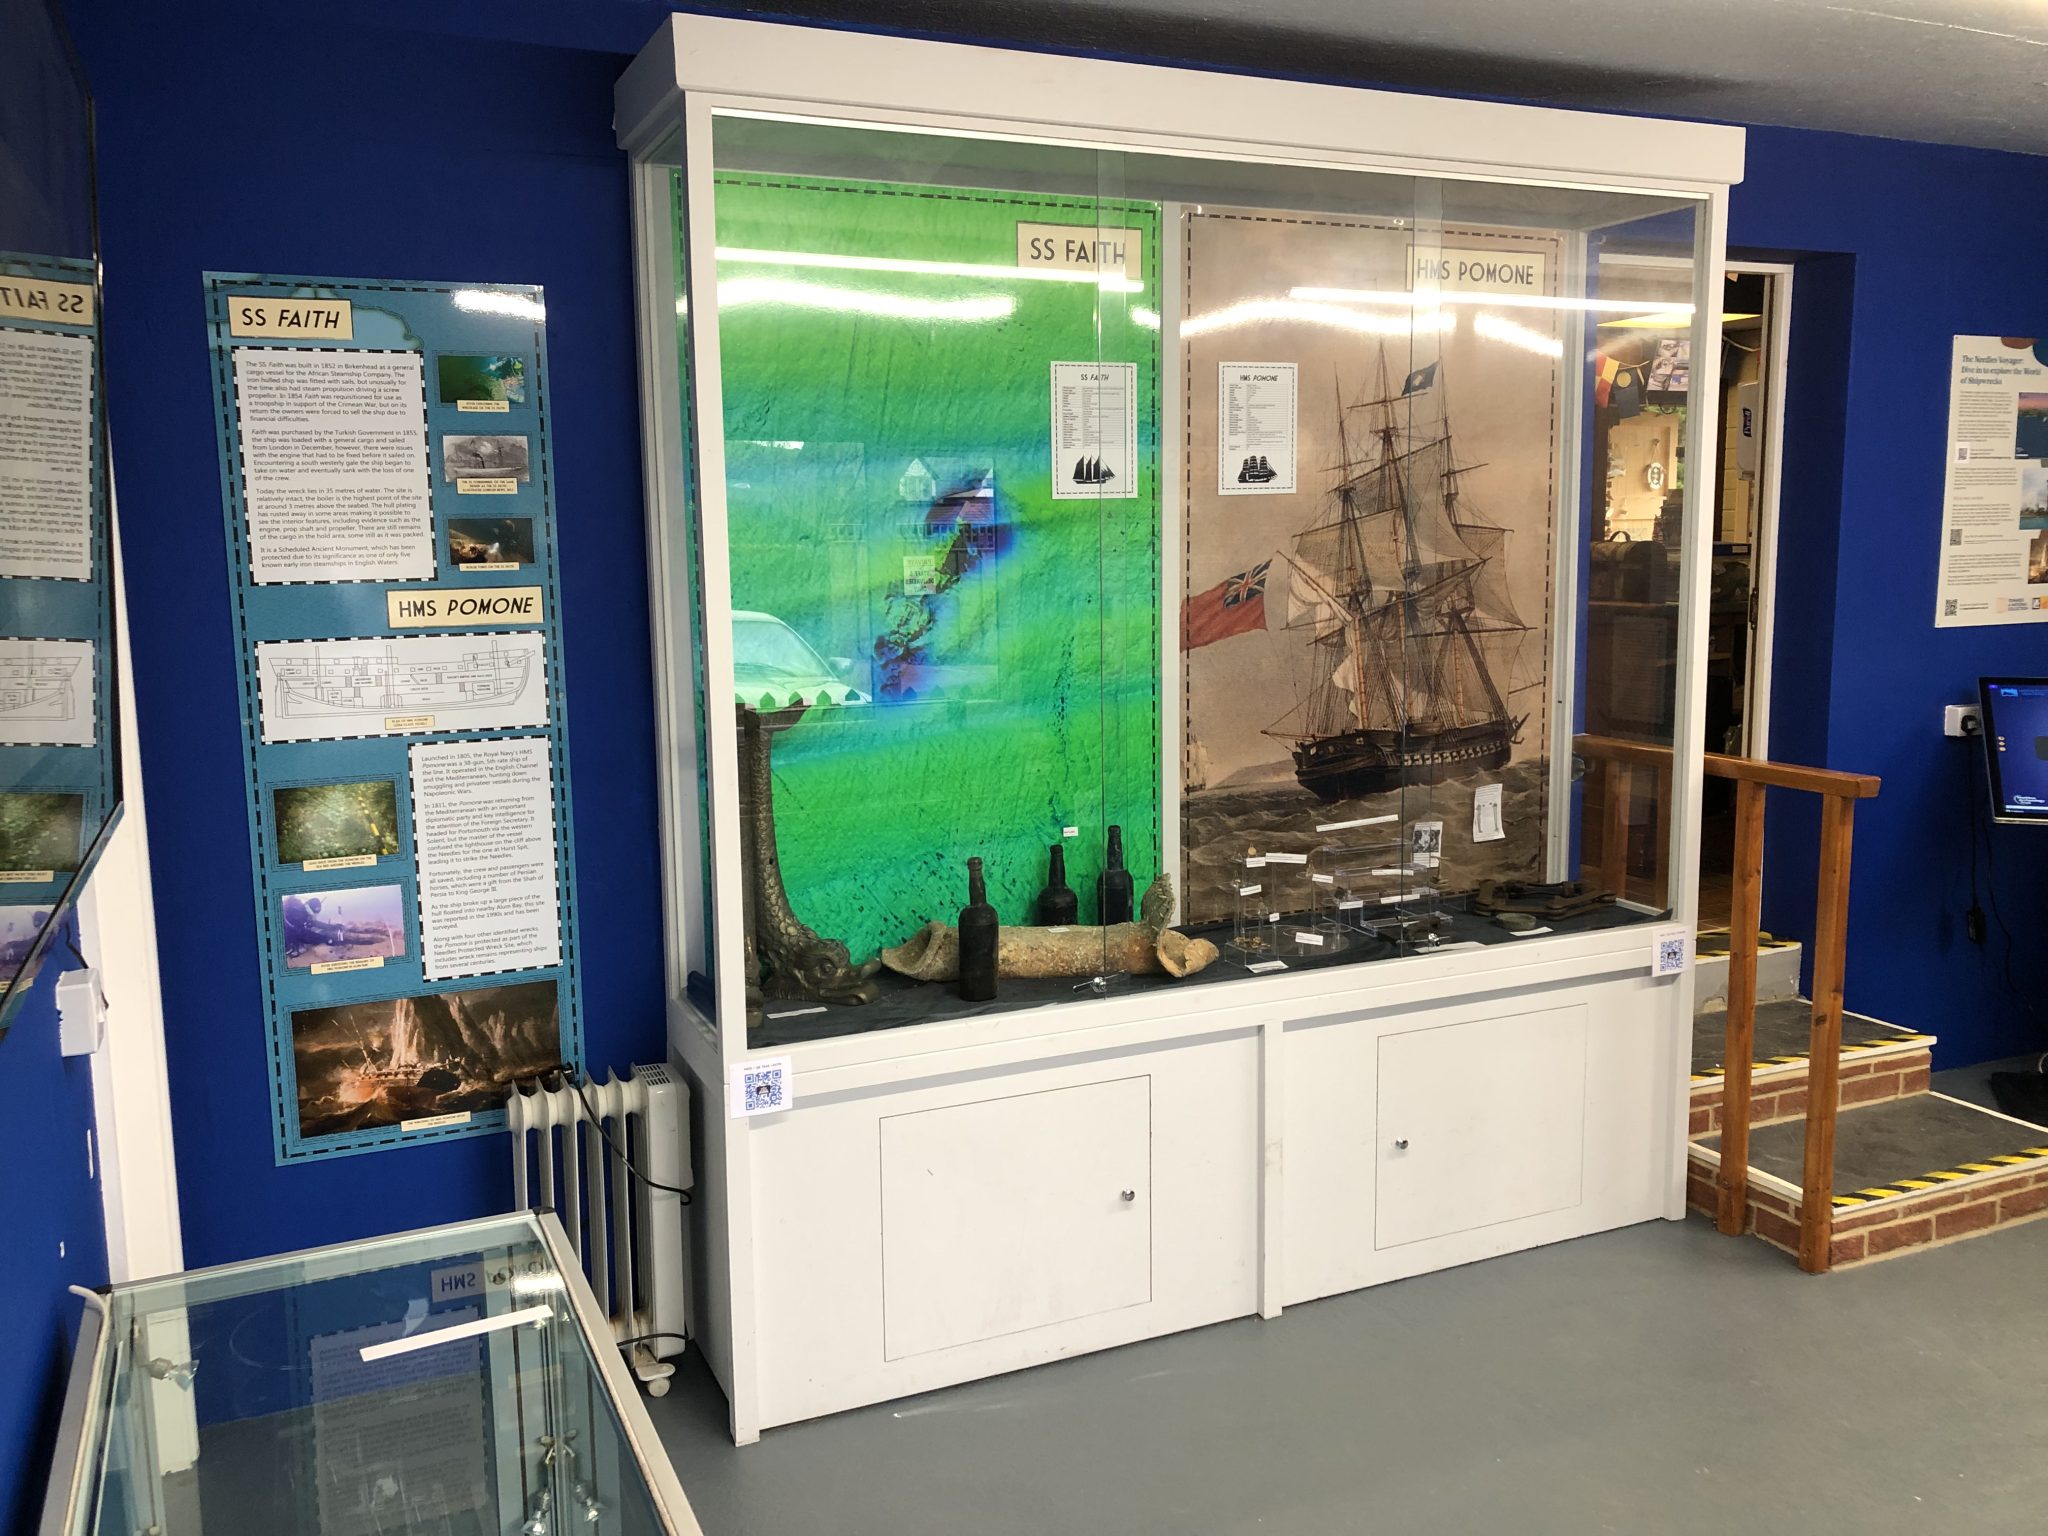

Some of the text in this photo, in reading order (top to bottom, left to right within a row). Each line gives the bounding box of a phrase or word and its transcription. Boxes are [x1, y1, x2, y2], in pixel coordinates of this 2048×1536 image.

[1030, 237, 1126, 264] SS FAITH
[1417, 258, 1534, 285] HMS POMONE
[242, 308, 340, 329] SS FAITH
[1962, 355, 1974, 364] The
[1975, 355, 1998, 364] Needles
[1961, 366, 1975, 374] Dive
[1976, 366, 1983, 374] in
[1990, 367, 2012, 376] explore
[2013, 367, 2022, 375] the
[2023, 367, 2041, 376] World
[1968, 377, 2003, 386] Shipwrecks
[398, 597, 534, 618] HMS POMONE
